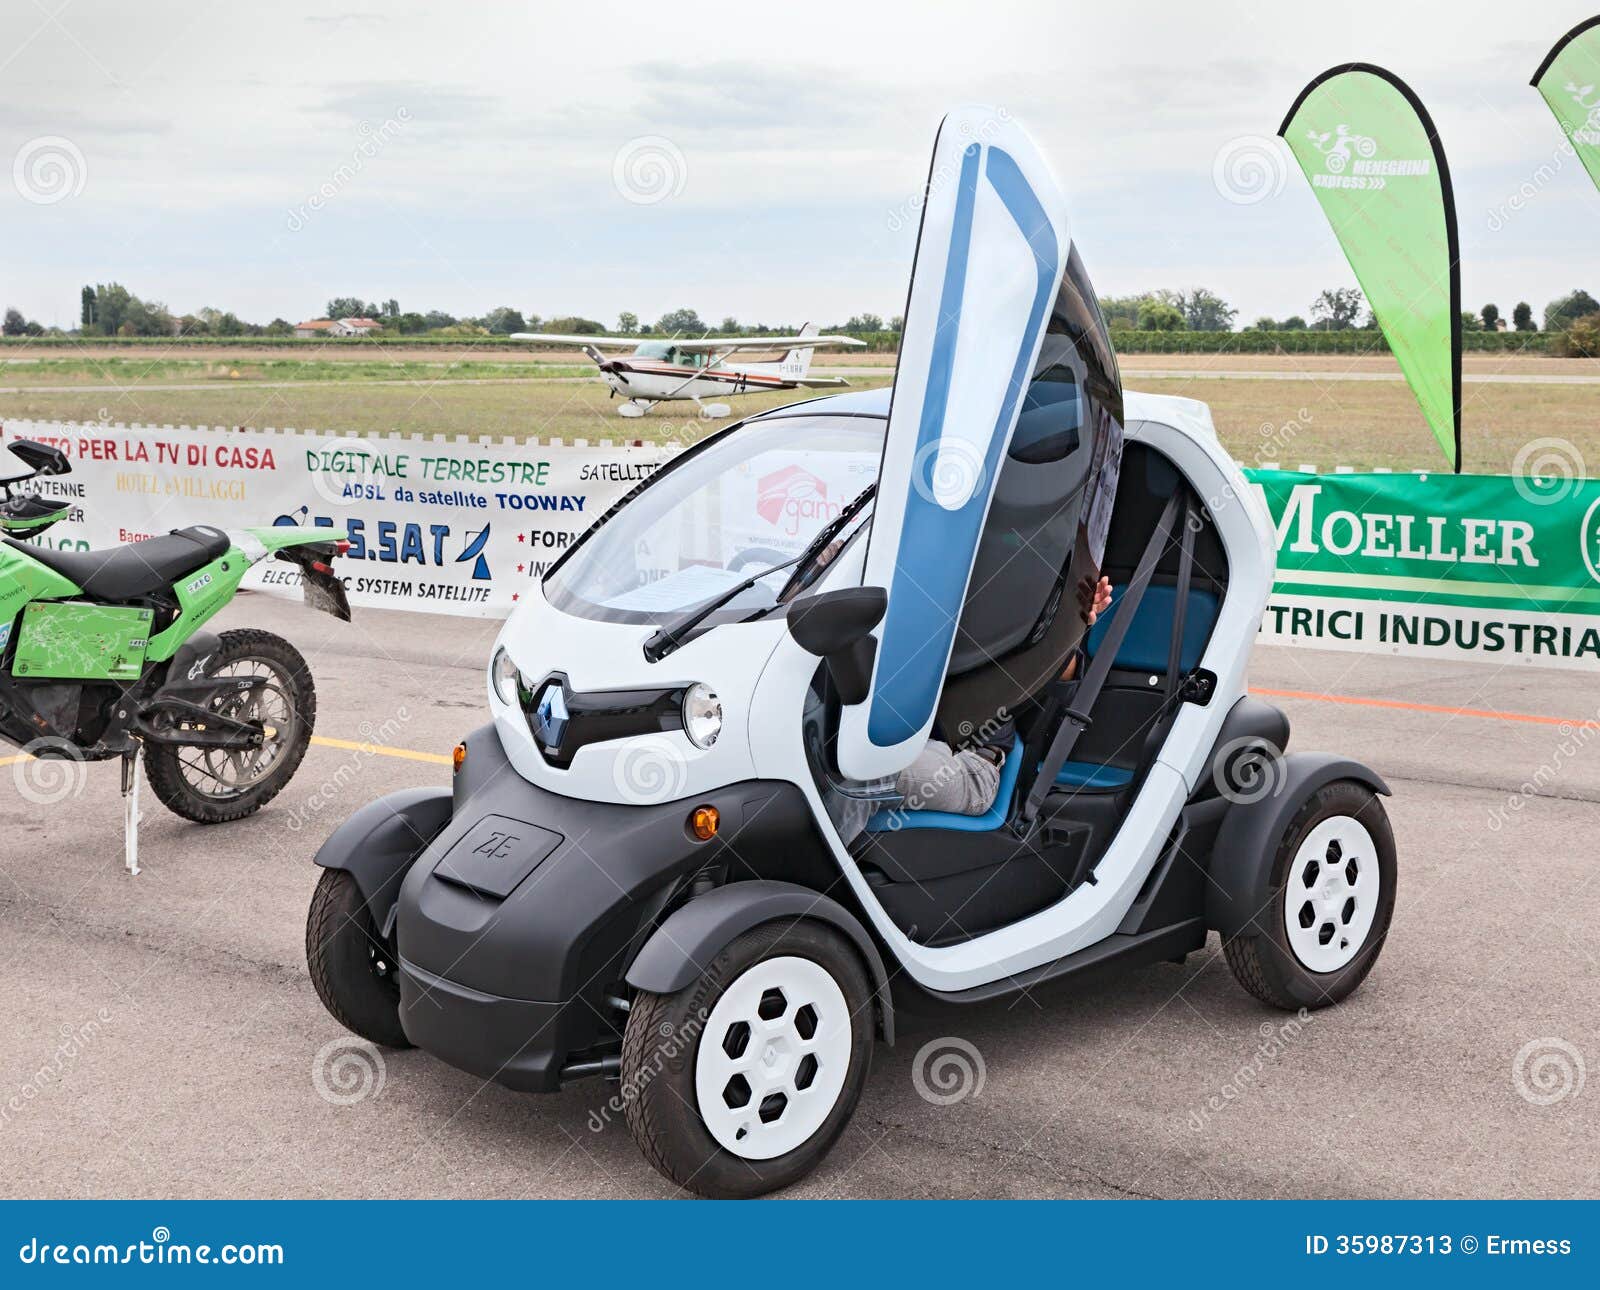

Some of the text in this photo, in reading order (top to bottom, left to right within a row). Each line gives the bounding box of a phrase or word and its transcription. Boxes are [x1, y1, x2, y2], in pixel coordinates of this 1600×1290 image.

[78, 438, 118, 460] PER
[125, 440, 149, 462] LA
[155, 442, 180, 464] TV
[187, 444, 207, 467] DI
[215, 446, 276, 470] CASA
[306, 450, 550, 486] DIGITALE TERRESTRE
[342, 483, 586, 512] ADSL da satellite TOOWAY
[1249, 483, 1540, 567] MOELLER
[356, 577, 412, 597] SYSTEM
[417, 584, 491, 602] SATELLITE
[1258, 604, 1364, 640] TRICI
